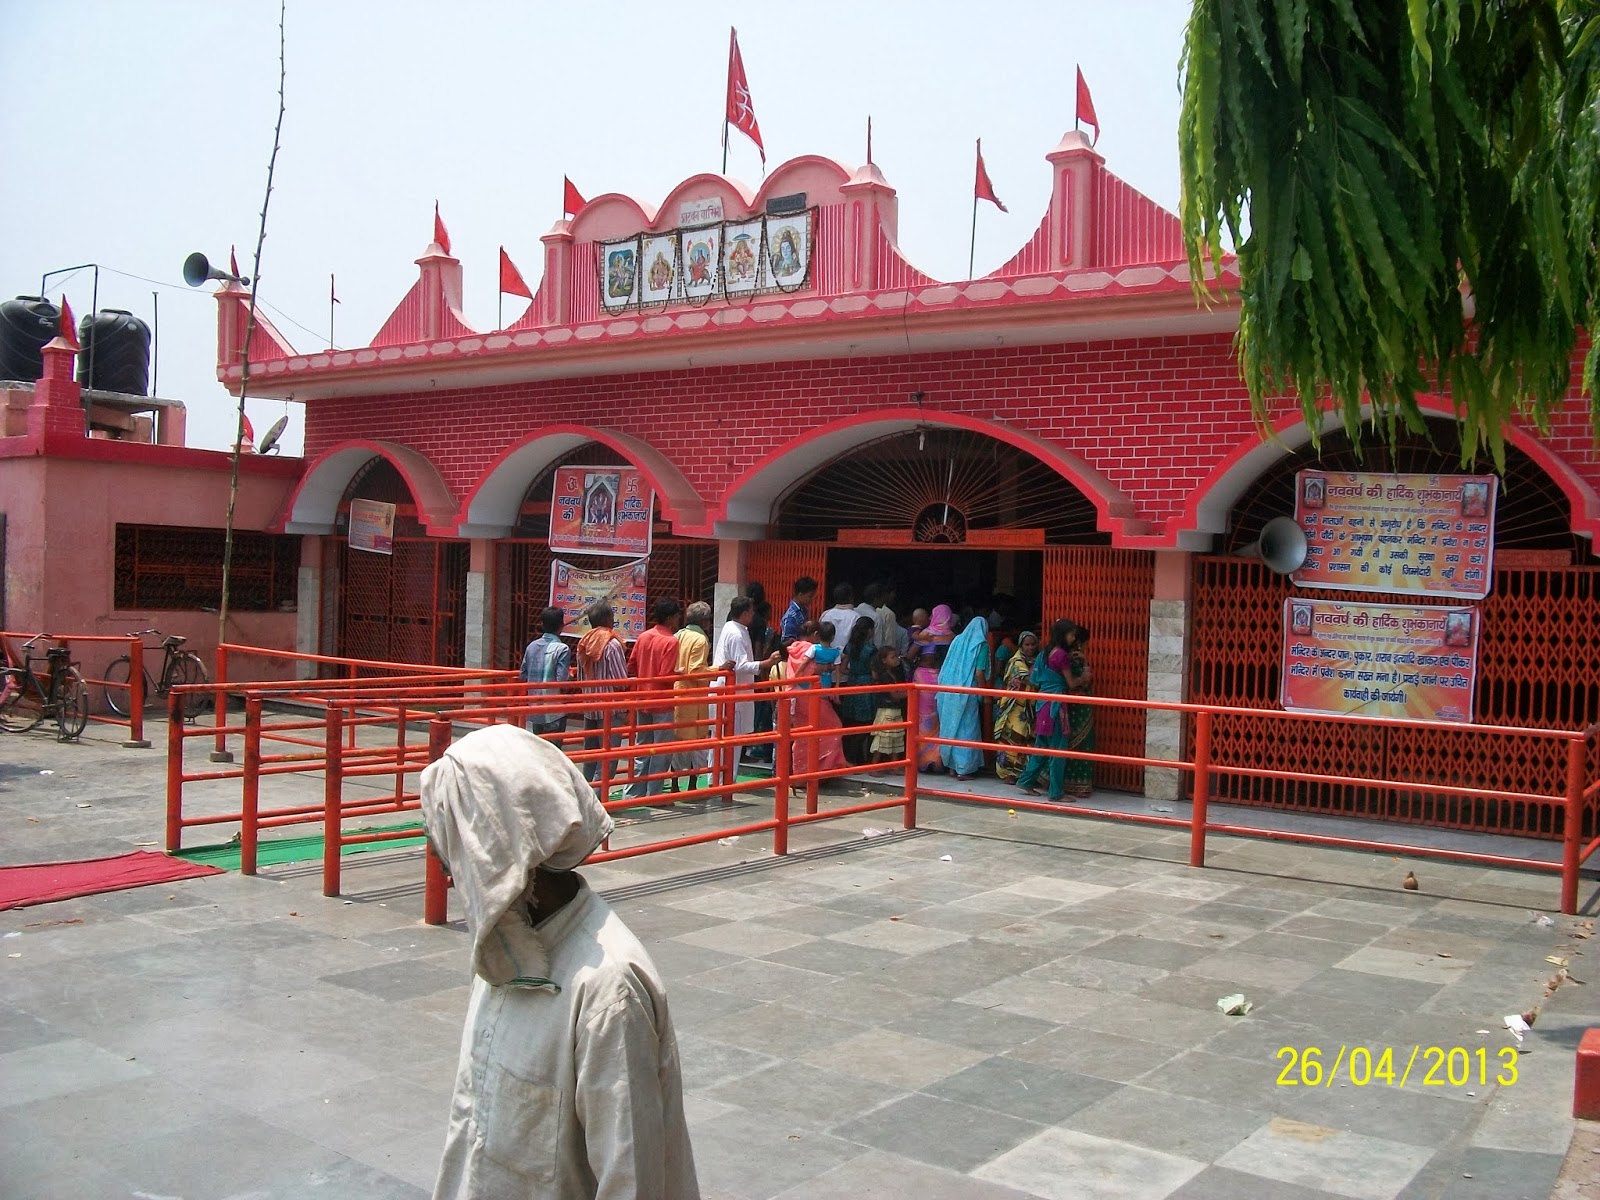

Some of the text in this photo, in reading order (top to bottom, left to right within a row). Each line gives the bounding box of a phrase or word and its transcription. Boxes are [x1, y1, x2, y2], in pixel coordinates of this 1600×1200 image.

[1327, 483, 1364, 498] नववर्ष
[1366, 483, 1383, 499] की
[1386, 484, 1414, 501] हार्दिक
[562, 507, 575, 520] की
[1369, 516, 1376, 528] से
[1380, 518, 1402, 533] अनुरोध
[1406, 518, 1412, 530] है
[1417, 518, 1426, 530] कि
[1431, 519, 1451, 531] मन्दिर
[1455, 520, 1463, 531] के
[1338, 531, 1346, 541] के
[1378, 534, 1403, 544] पहनकर
[1407, 533, 1426, 546] मन्दिर
[1430, 535, 1438, 546] में
[1442, 536, 1458, 548] प्रवेश
[1462, 538, 1469, 547] न
[1332, 547, 1341, 557] आ
[1372, 547, 1380, 558] तो
[1389, 548, 1409, 560] उसकी
[1328, 562, 1351, 572] प्रशासन
[1360, 561, 1370, 573] की
[1378, 563, 1393, 576] कोई
[1314, 610, 1351, 625] नववर्ष
[1352, 612, 1370, 627] की
[1372, 613, 1399, 630] हार्दिक
[1291, 642, 1310, 657] मन्दिर
[1311, 644, 1318, 657] के
[1320, 648, 1336, 658] अन्दर
[1393, 651, 1415, 664] इत्यादि
[1451, 654, 1470, 668] पीकर
[1291, 662, 1309, 676] मन्दिर
[1320, 665, 1335, 678] प्रवेश
[1338, 669, 1355, 680] करना
[1376, 672, 1390, 682] मना
[1421, 673, 1438, 686] जाने
[1440, 677, 1449, 687] पर
[1450, 673, 1468, 688] उचित
[1343, 686, 1369, 701] कार्यवाही
[1370, 687, 1380, 702] की
